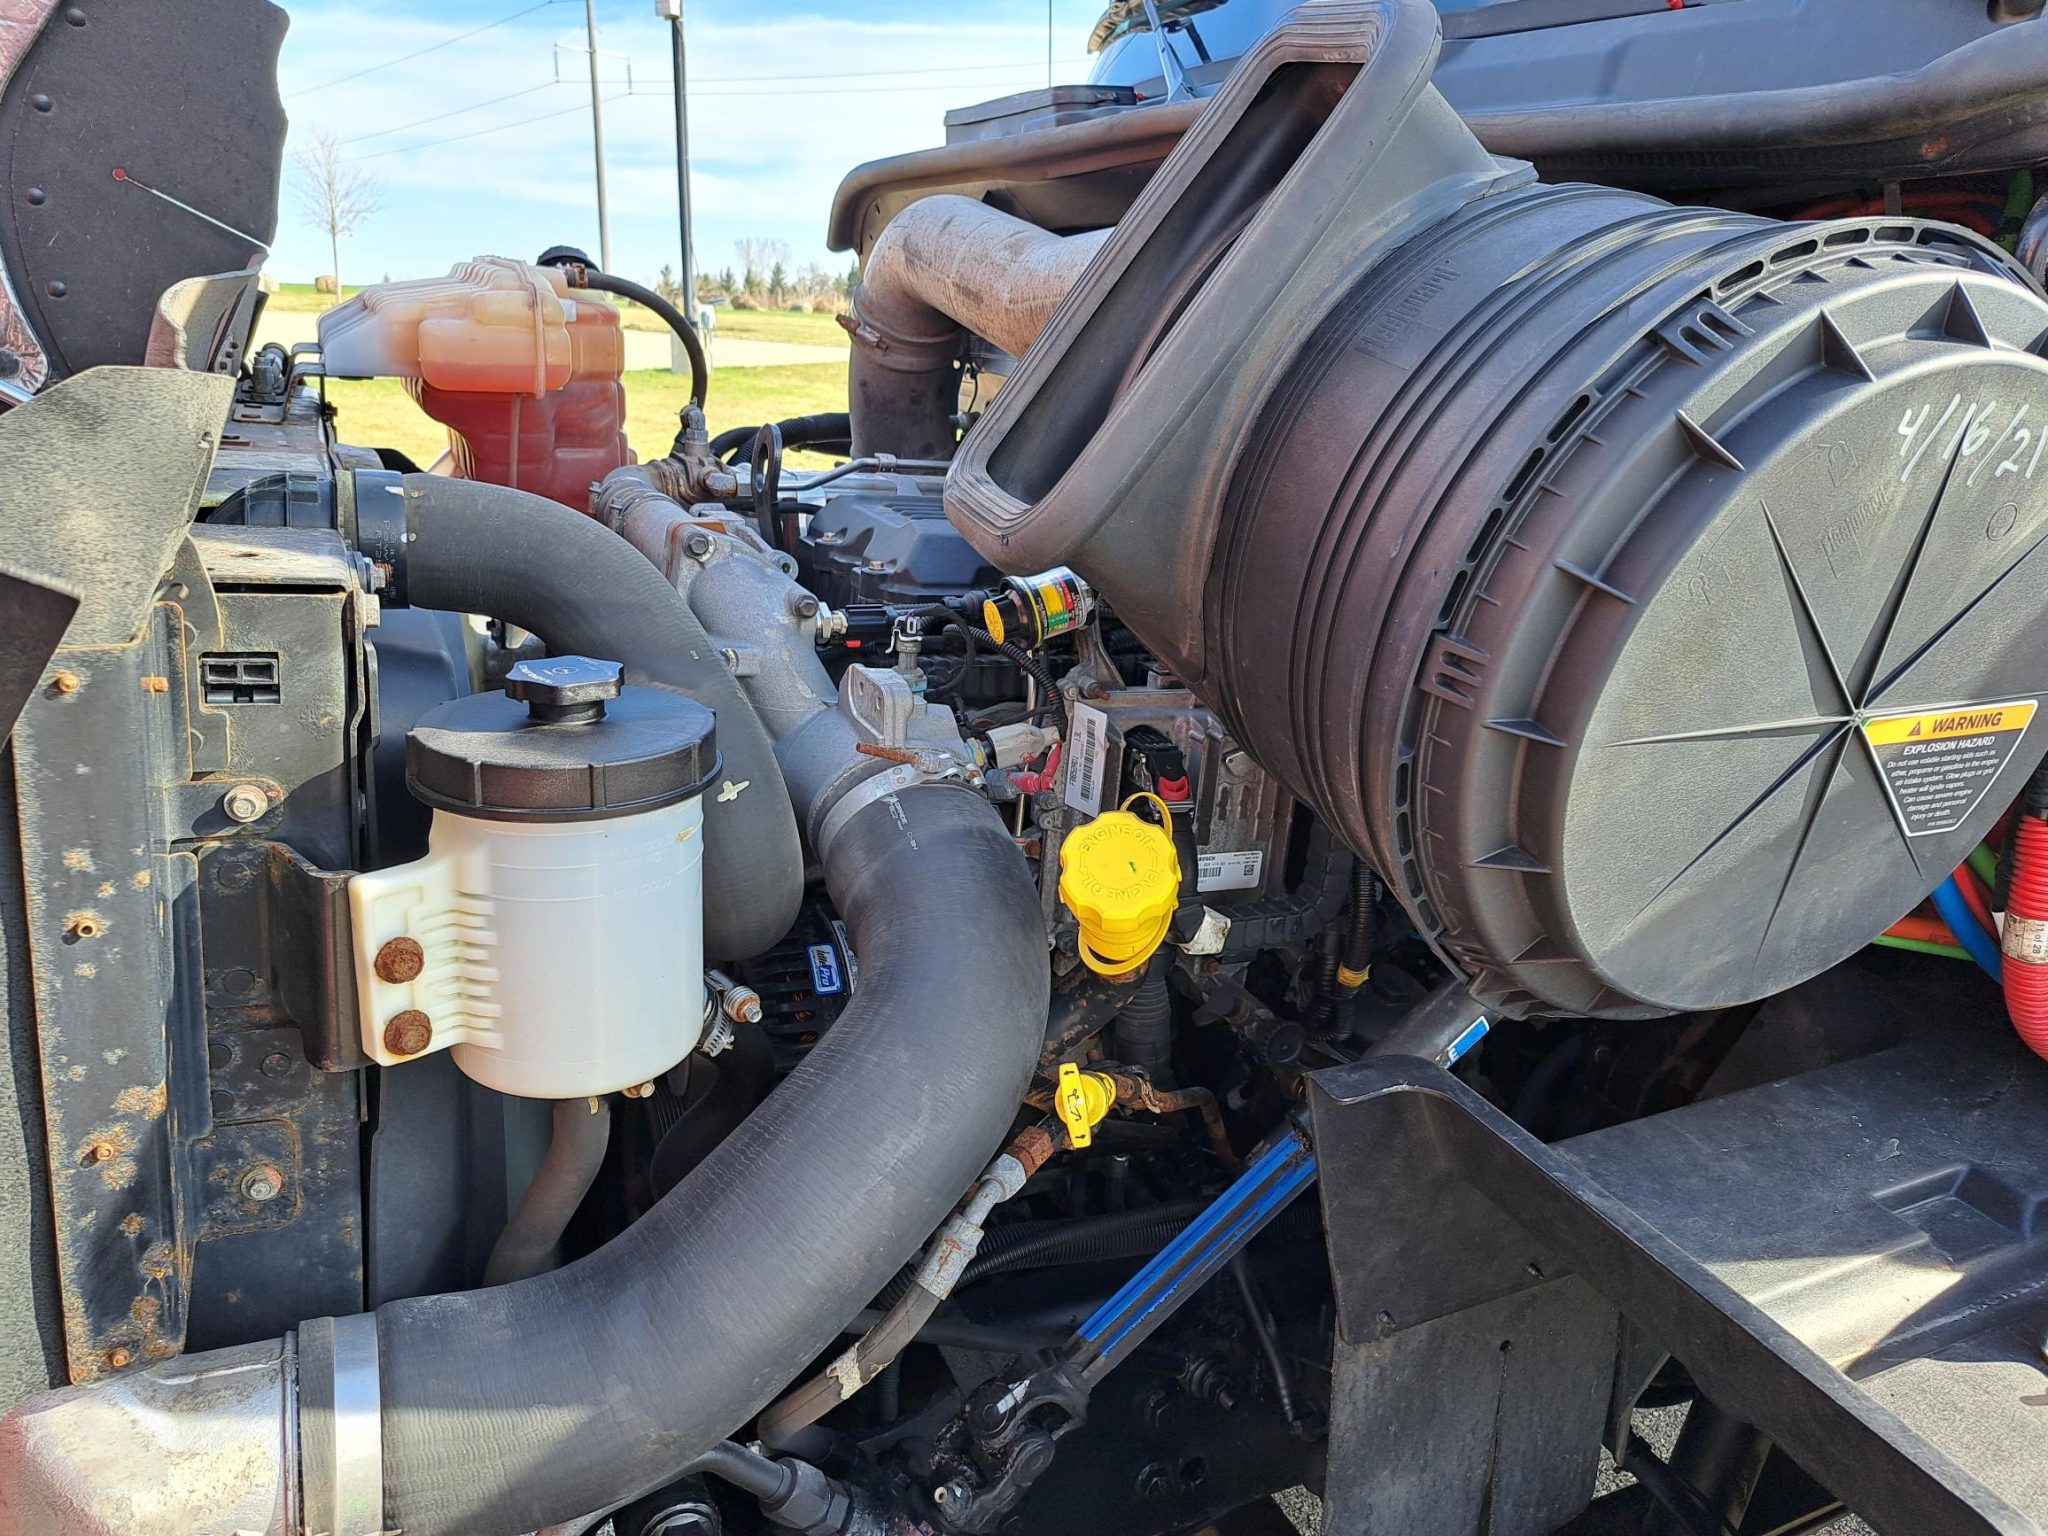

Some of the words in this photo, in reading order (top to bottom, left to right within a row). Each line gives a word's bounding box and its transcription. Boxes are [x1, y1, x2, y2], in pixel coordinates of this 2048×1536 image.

[1898, 394, 2048, 488] 4/16/21
[1932, 712, 2002, 733] WARNING
[1903, 741, 1957, 755] EXPLOSION
[1956, 736, 1995, 749] HAZARD
[1897, 759, 1907, 767] not
[1079, 823, 1131, 853] ENGINE
[1132, 828, 1160, 856] OIL
[1079, 866, 1105, 896] OIL
[1106, 869, 1160, 902] ENGINE
[2036, 922, 2044, 931] 11
[2034, 934, 2042, 942] of
[2032, 944, 2041, 954] 28
